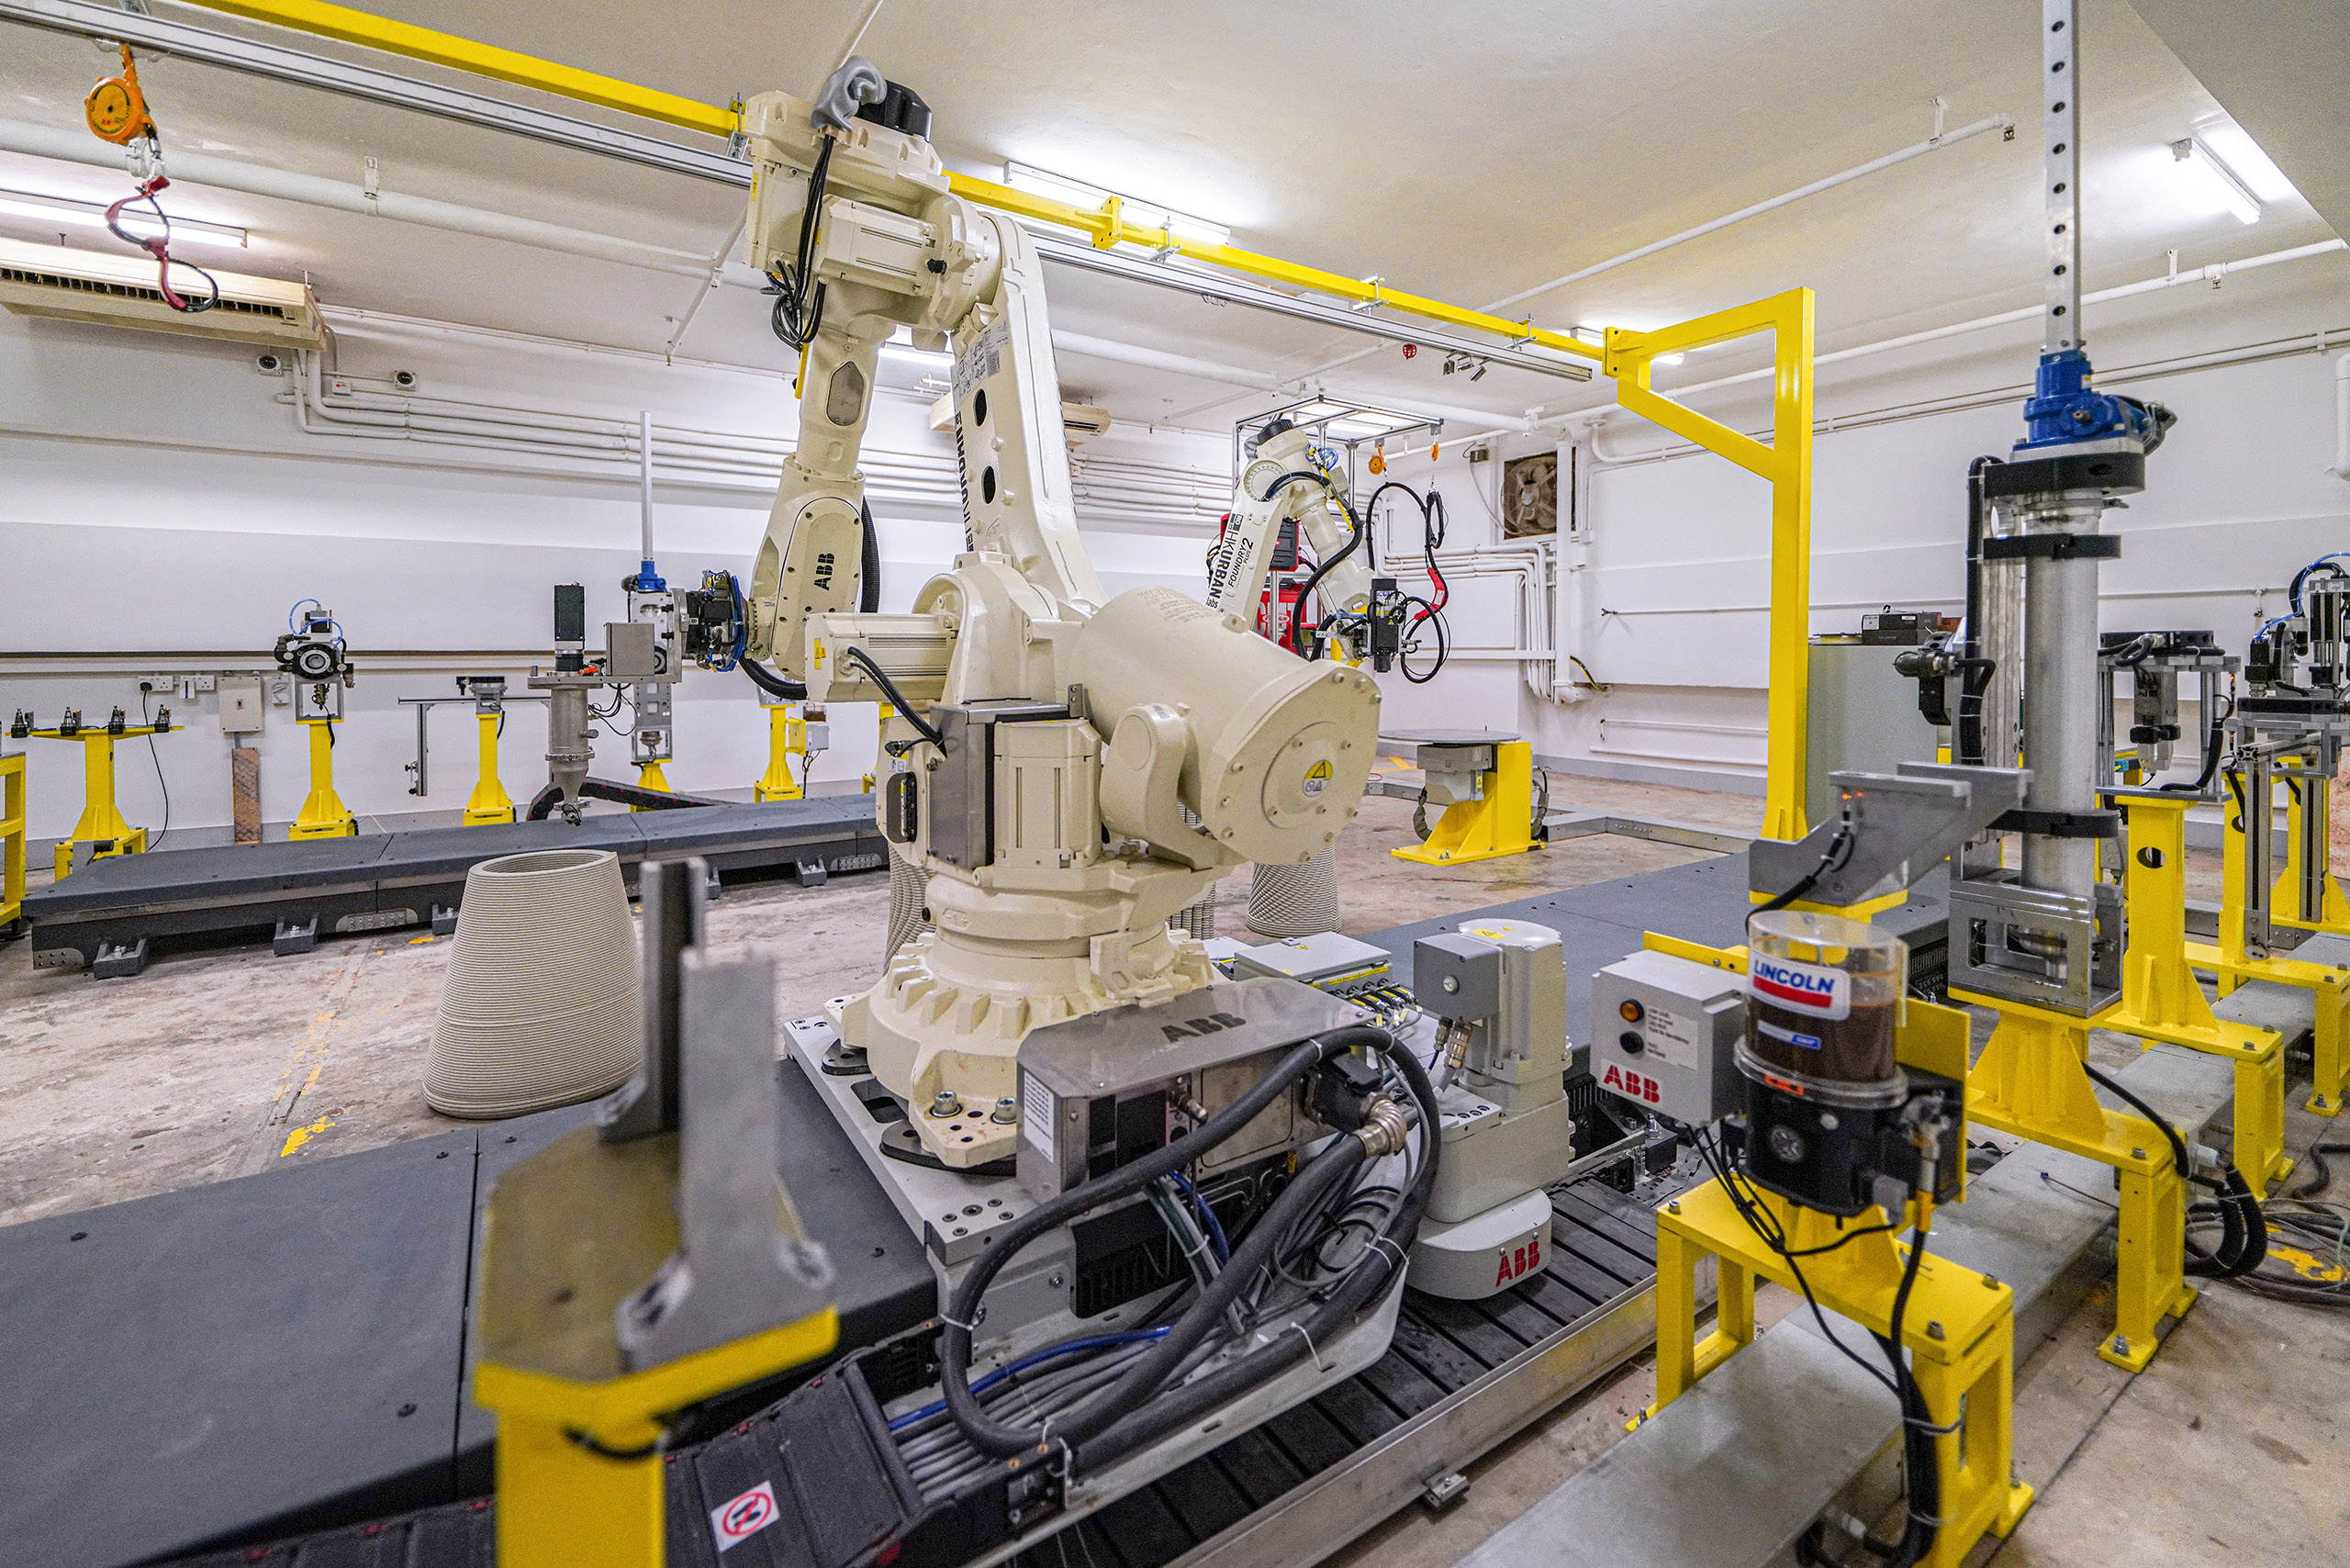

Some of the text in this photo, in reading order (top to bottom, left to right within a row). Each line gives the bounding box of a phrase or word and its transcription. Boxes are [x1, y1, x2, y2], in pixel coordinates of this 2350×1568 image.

[813, 553, 835, 591] ABB
[1228, 543, 1247, 588] FOUNDRY
[1205, 597, 1219, 609] labs
[1754, 959, 1835, 993] LINCOLN
[1160, 1013, 1247, 1044] ABB
[1603, 1065, 1660, 1103] ABB
[1495, 1240, 1540, 1288] ABB
